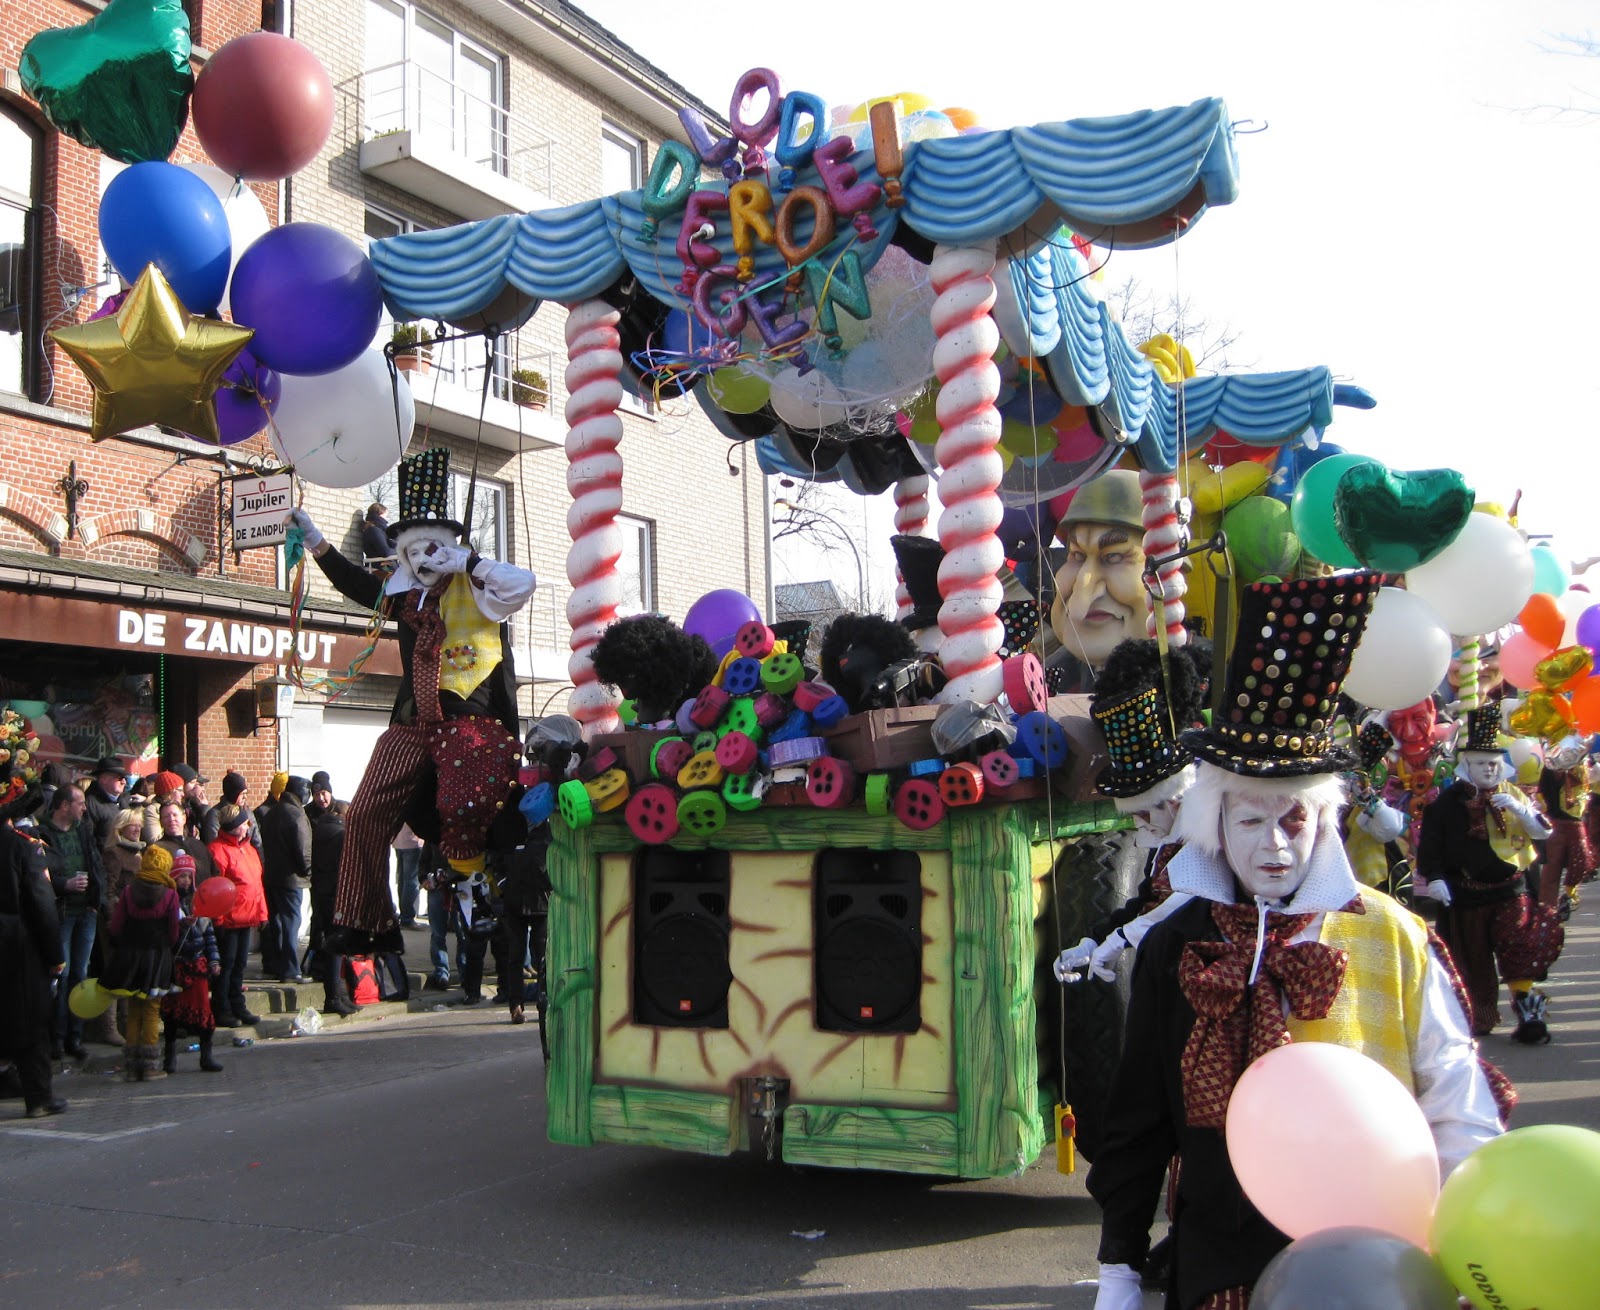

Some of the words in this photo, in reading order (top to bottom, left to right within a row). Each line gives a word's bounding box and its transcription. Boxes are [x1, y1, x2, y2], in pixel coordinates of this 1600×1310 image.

[240, 494, 286, 511] Jupiler
[236, 528, 247, 540] DE
[251, 523, 285, 538] ZANDPU
[118, 609, 167, 647] DE
[184, 617, 337, 663] ZANDPUT
